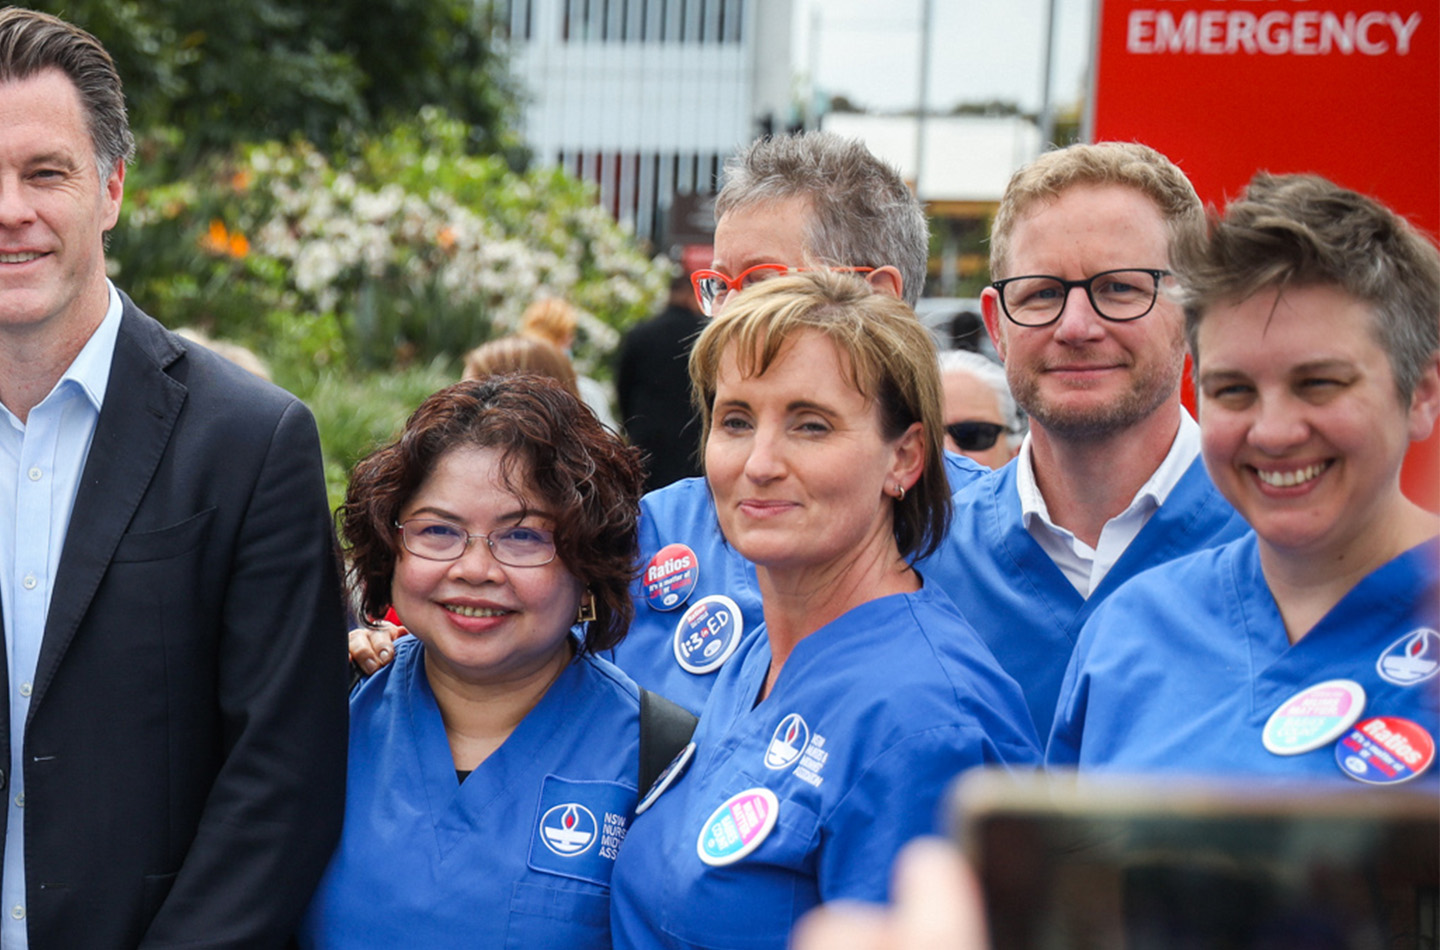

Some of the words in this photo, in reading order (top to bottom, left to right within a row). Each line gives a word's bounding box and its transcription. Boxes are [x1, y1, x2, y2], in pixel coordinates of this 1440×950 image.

[1126, 10, 1422, 55] EMERGENCY
[648, 555, 690, 581] Ratios
[707, 611, 729, 635] ED
[1363, 719, 1422, 764] Ratios
[604, 812, 626, 827] NSW
[601, 835, 619, 848] MID
